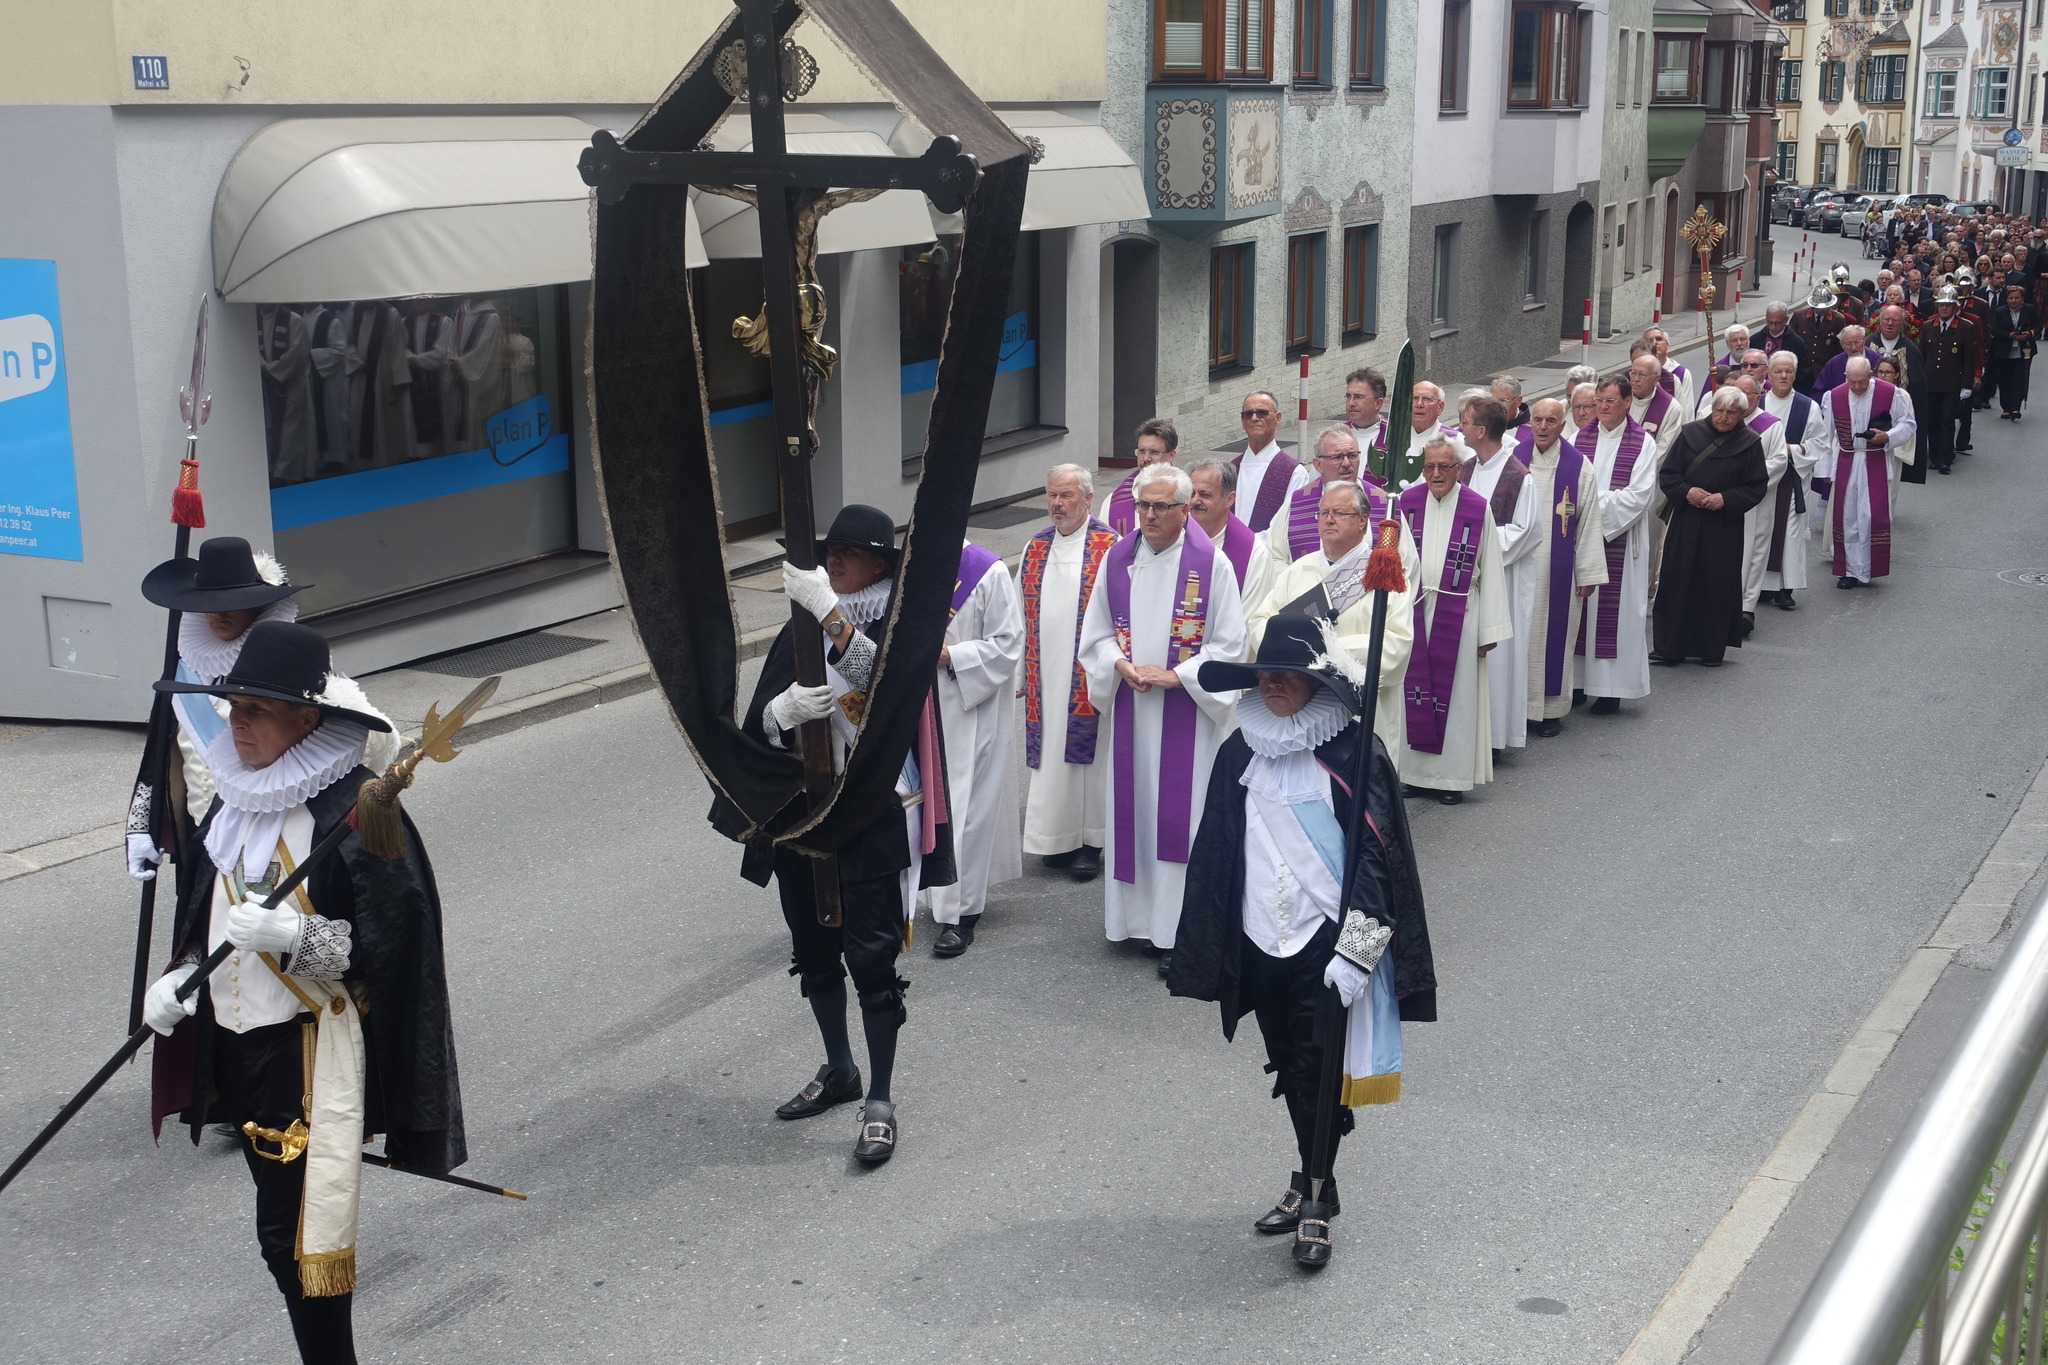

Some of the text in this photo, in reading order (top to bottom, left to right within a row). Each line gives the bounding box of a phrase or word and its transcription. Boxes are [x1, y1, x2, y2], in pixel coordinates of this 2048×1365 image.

[139, 58, 163, 79] 110
[1019, 322, 1026, 342] P
[31, 341, 53, 380] P
[492, 411, 549, 458] plan P
[8, 503, 24, 517] Ing.
[25, 505, 50, 518] Klaus
[51, 507, 72, 520] Peer
[10, 519, 20, 530] 38
[21, 520, 33, 531] 32
